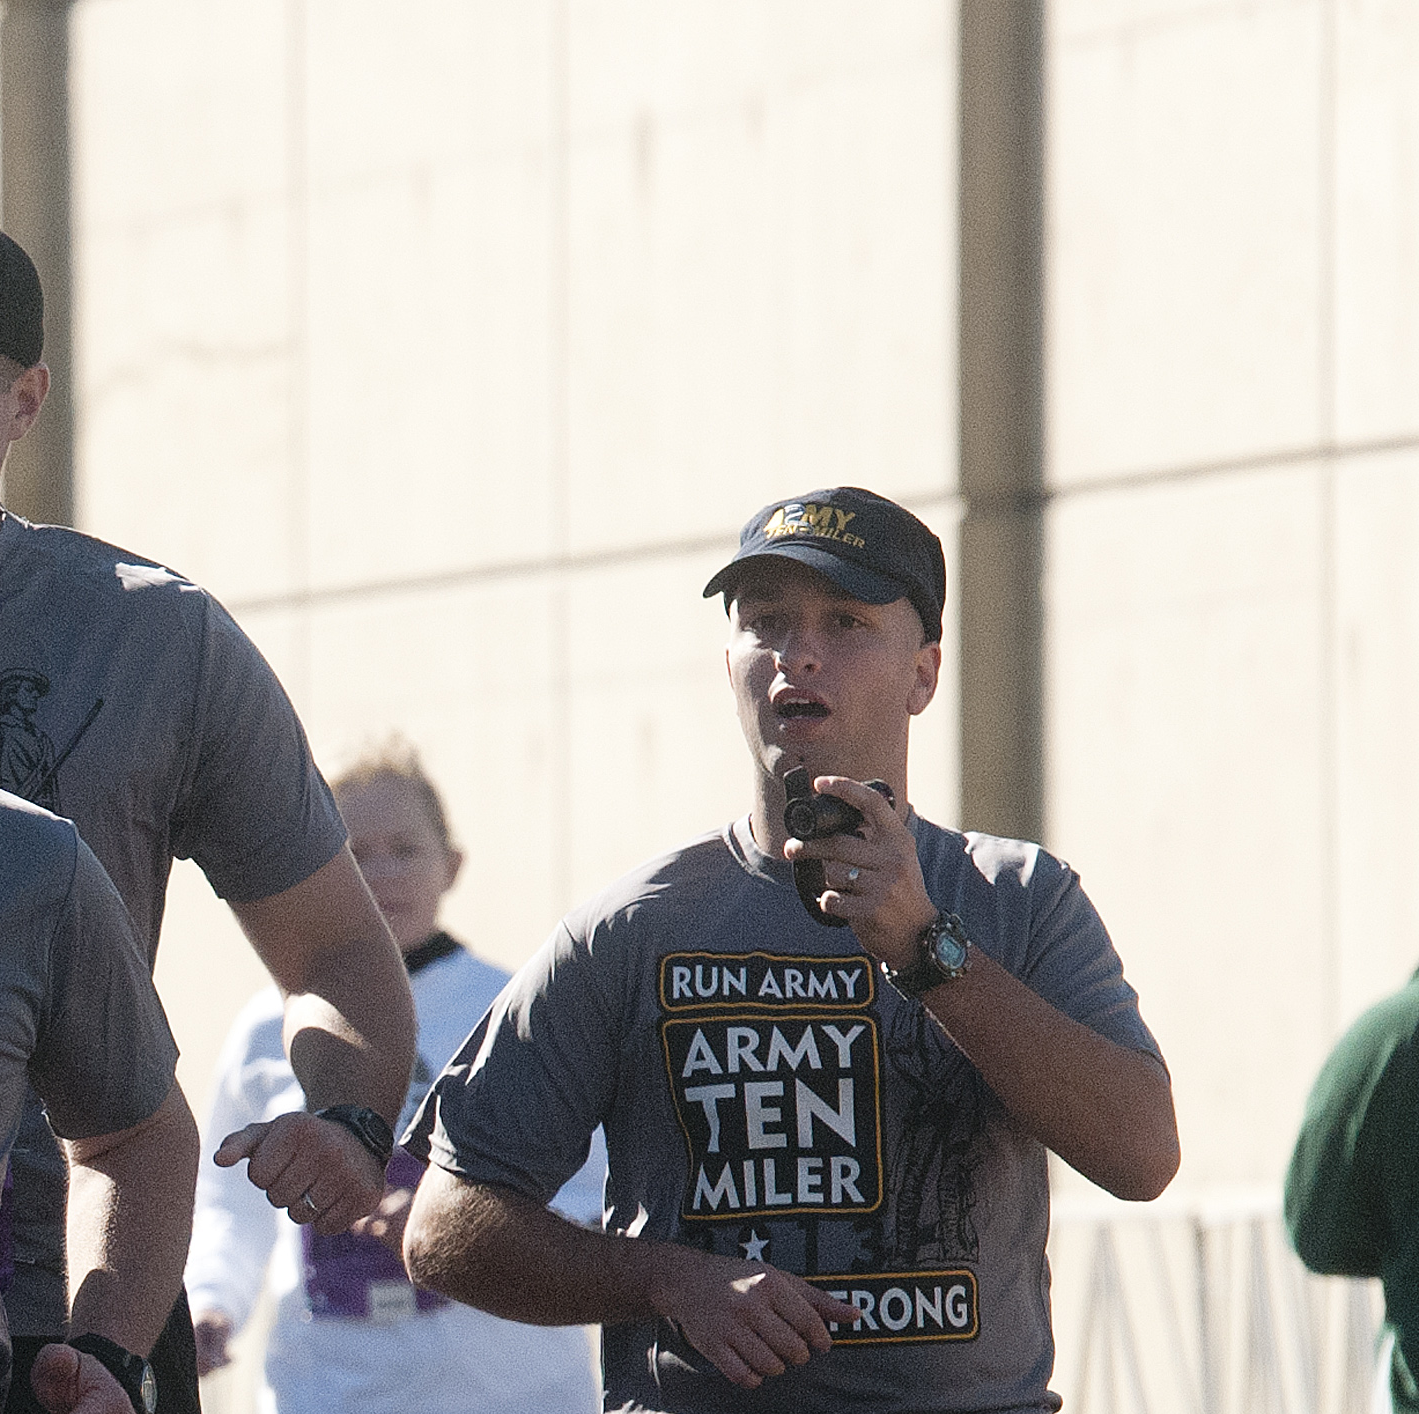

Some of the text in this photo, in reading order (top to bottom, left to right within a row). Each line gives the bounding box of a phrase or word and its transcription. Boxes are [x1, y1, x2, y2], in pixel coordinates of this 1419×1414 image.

[765, 522, 866, 549] TEN-MILER
[673, 965, 862, 999] RUN ARMY
[682, 1024, 865, 1077] ARMY
[685, 1077, 854, 1153] TEN
[692, 1156, 865, 1211] MILER
